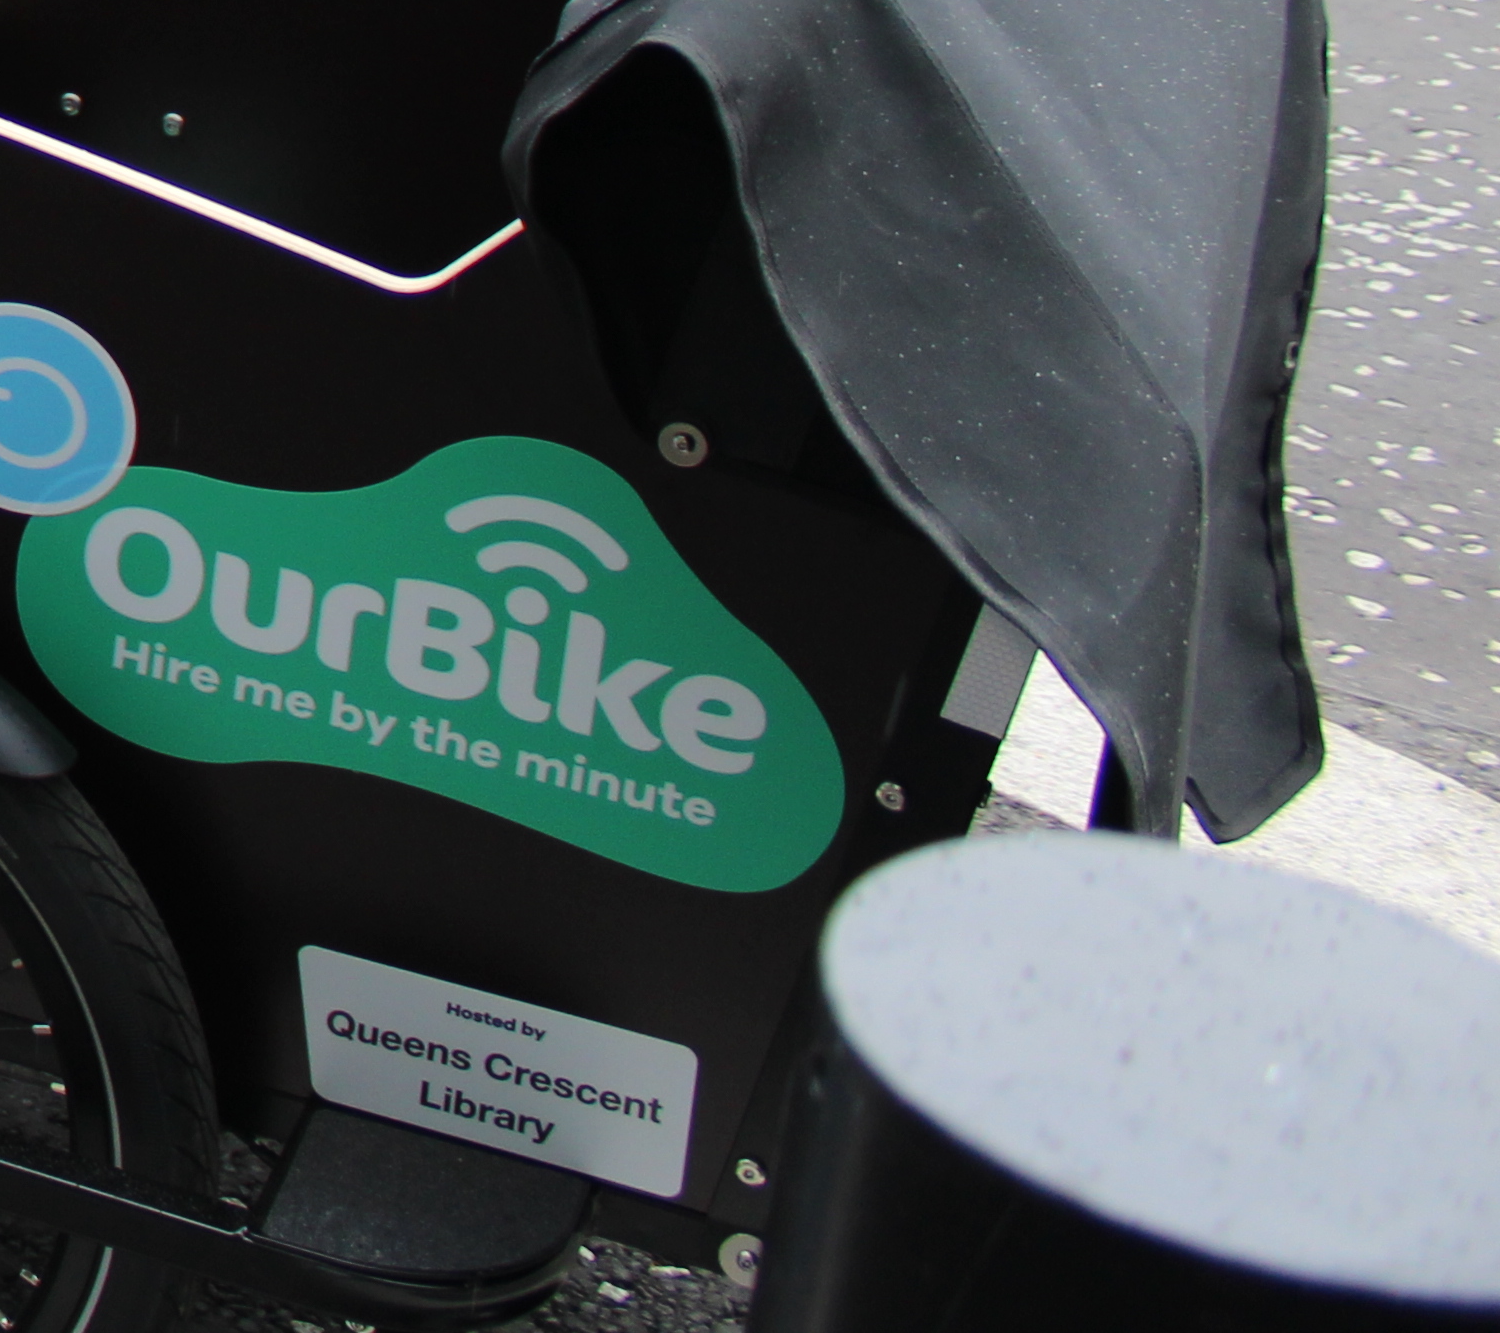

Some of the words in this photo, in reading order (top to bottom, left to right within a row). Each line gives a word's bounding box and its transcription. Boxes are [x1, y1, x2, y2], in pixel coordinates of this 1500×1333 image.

[84, 505, 767, 775] OurBike
[111, 634, 221, 696] Hire
[233, 669, 317, 721] me
[329, 690, 397, 748] by
[409, 715, 501, 770] the
[516, 752, 717, 829] minute
[326, 1008, 473, 1073] Queens
[483, 1051, 664, 1126] Crescent
[446, 1000, 517, 1033] Hosted
[521, 1021, 547, 1042] by
[419, 1080, 556, 1145] Library
